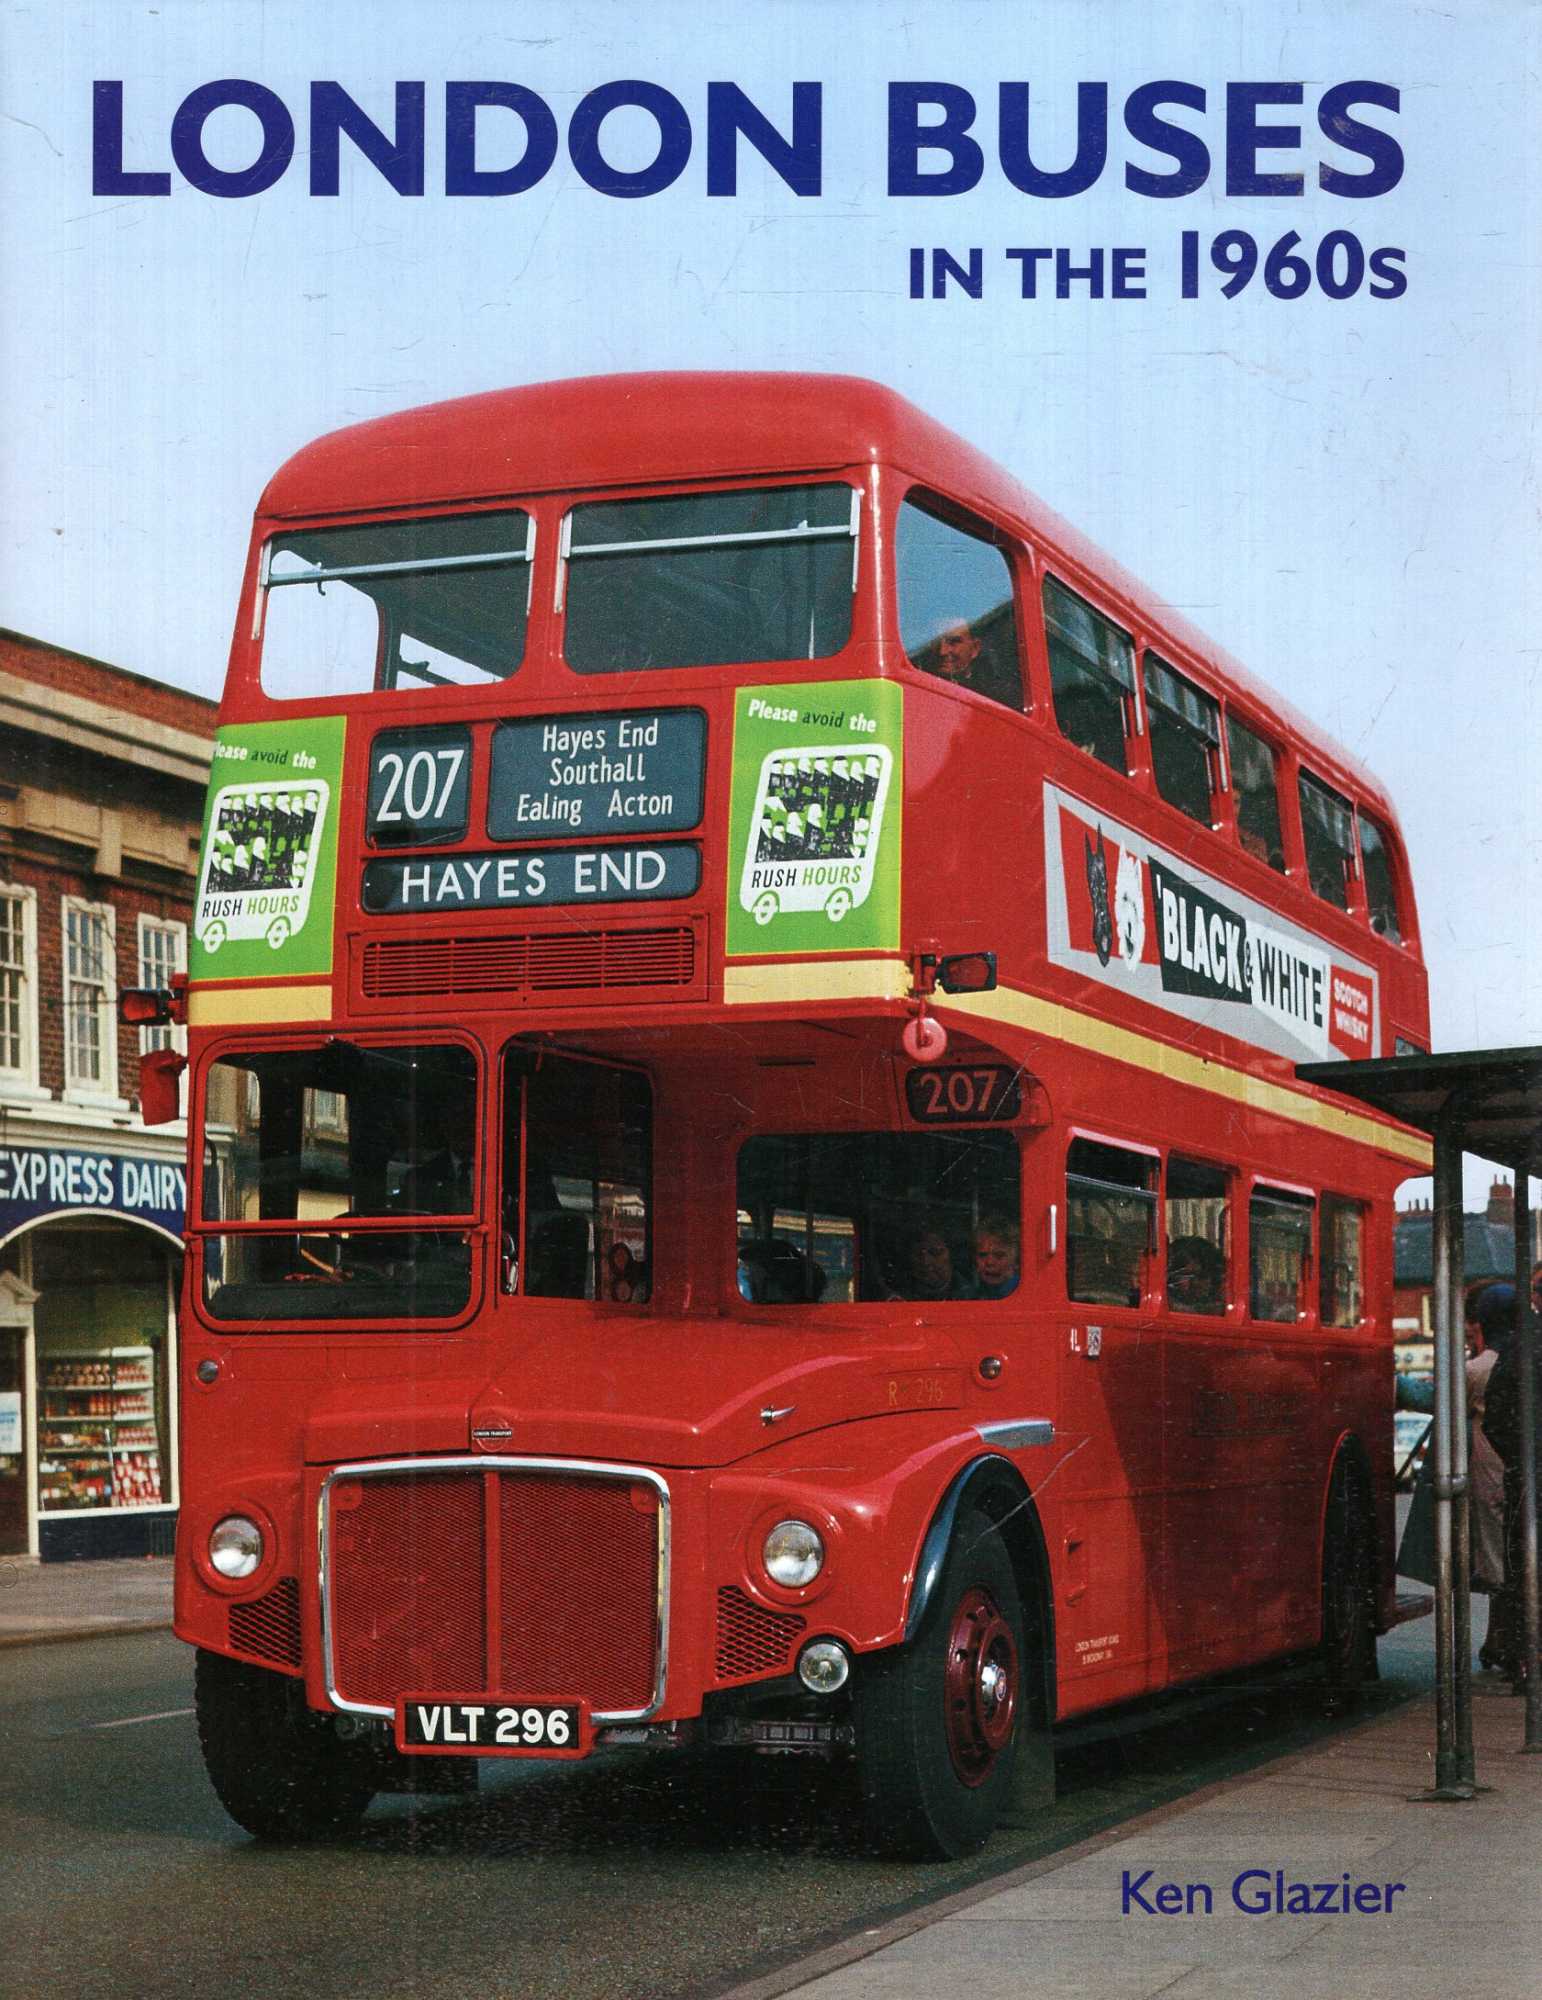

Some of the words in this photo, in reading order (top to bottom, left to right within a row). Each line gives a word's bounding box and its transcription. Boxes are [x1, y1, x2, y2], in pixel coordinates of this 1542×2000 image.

[748, 699, 798, 724] Please
[802, 711, 844, 728] avoid
[849, 715, 877, 733] the
[213, 741, 248, 761] lease
[250, 750, 289, 765] avoid
[292, 750, 317, 769] the
[543, 725, 605, 757] Hayes
[618, 718, 659, 747] End
[375, 750, 465, 823] 207
[549, 758, 646, 787] Southall
[516, 794, 583, 825] Ealing
[607, 789, 673, 818] Acton
[401, 858, 546, 904] HAYES
[574, 850, 667, 894] END
[751, 869, 797, 889] RUSH
[802, 865, 863, 886] HOURS
[202, 896, 243, 918] RUSH
[247, 895, 300, 914] HOURS
[920, 1071, 998, 1113] 207
[0, 1151, 114, 1204] EXPRESS
[121, 1161, 187, 1211] DAIRY
[417, 1706, 485, 1742] VLT
[495, 1707, 570, 1745] 296
